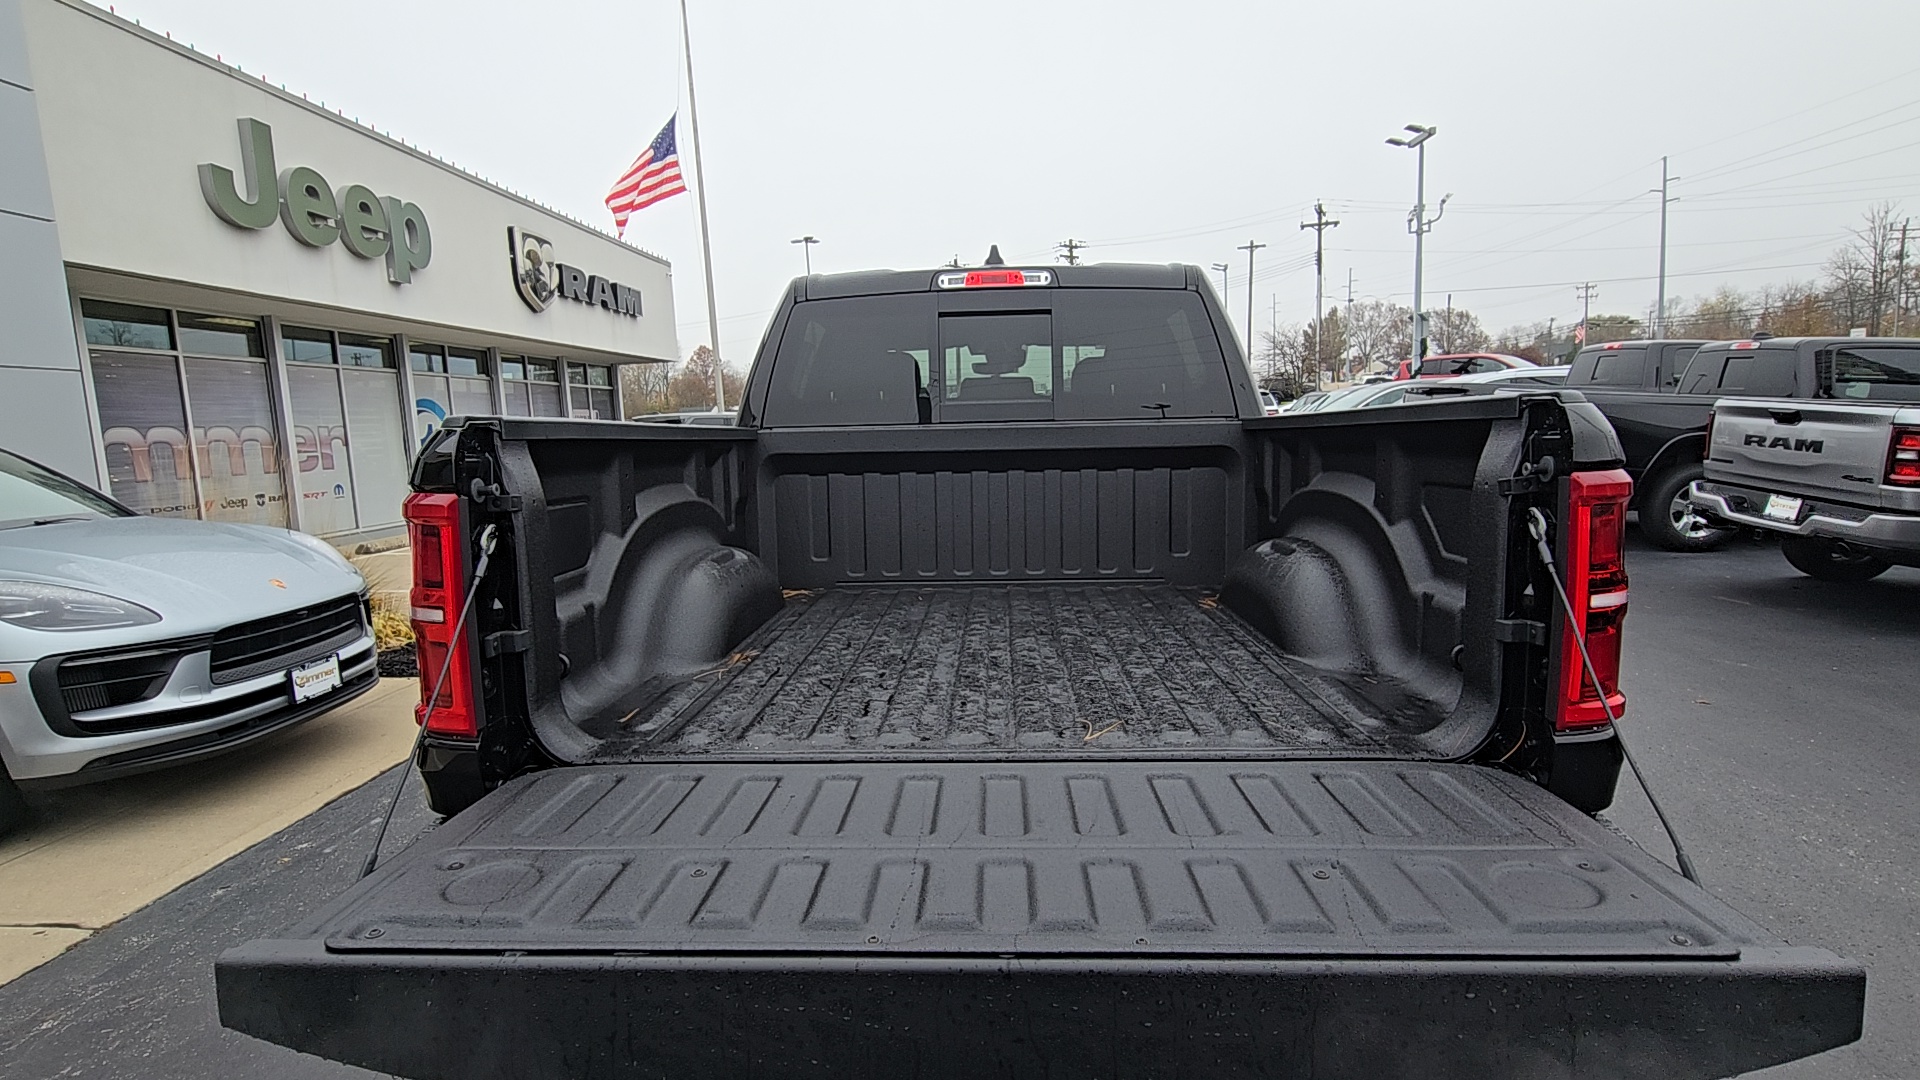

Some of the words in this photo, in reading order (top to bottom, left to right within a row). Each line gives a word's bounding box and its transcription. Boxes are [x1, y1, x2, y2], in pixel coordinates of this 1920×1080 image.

[197, 116, 433, 285] Jeep
[555, 262, 644, 318] RAM
[1743, 434, 1824, 453] RAM
[220, 496, 248, 509] Jeep
[303, 491, 328, 499] SRT
[150, 504, 199, 514] DODG
